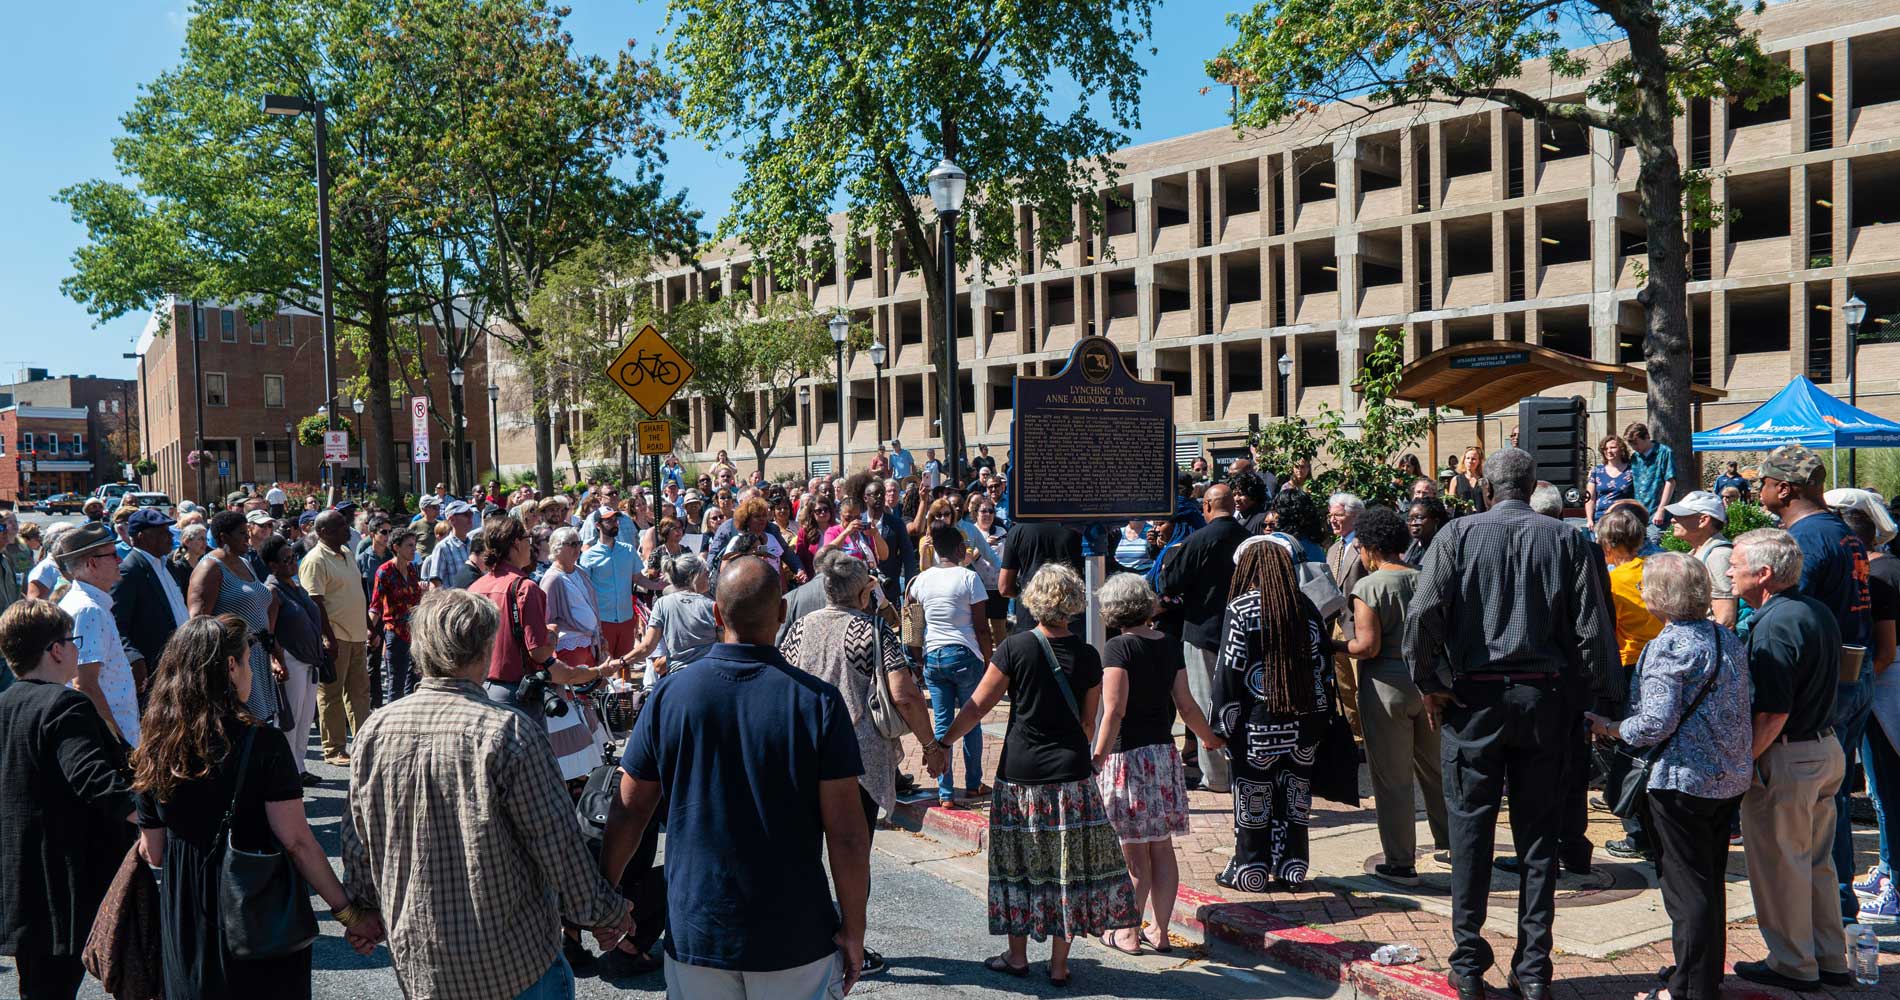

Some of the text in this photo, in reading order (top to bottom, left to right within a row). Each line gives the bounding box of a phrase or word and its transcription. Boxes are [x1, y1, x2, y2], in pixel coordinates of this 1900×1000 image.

[1070, 385, 1124, 396] LYNCHING IN
[1045, 394, 1147, 406] ANNE ARUNDEL COUNTY
[643, 424, 665, 432] SHARE
[648, 433, 660, 441] THE
[646, 442, 664, 450] ROAD
